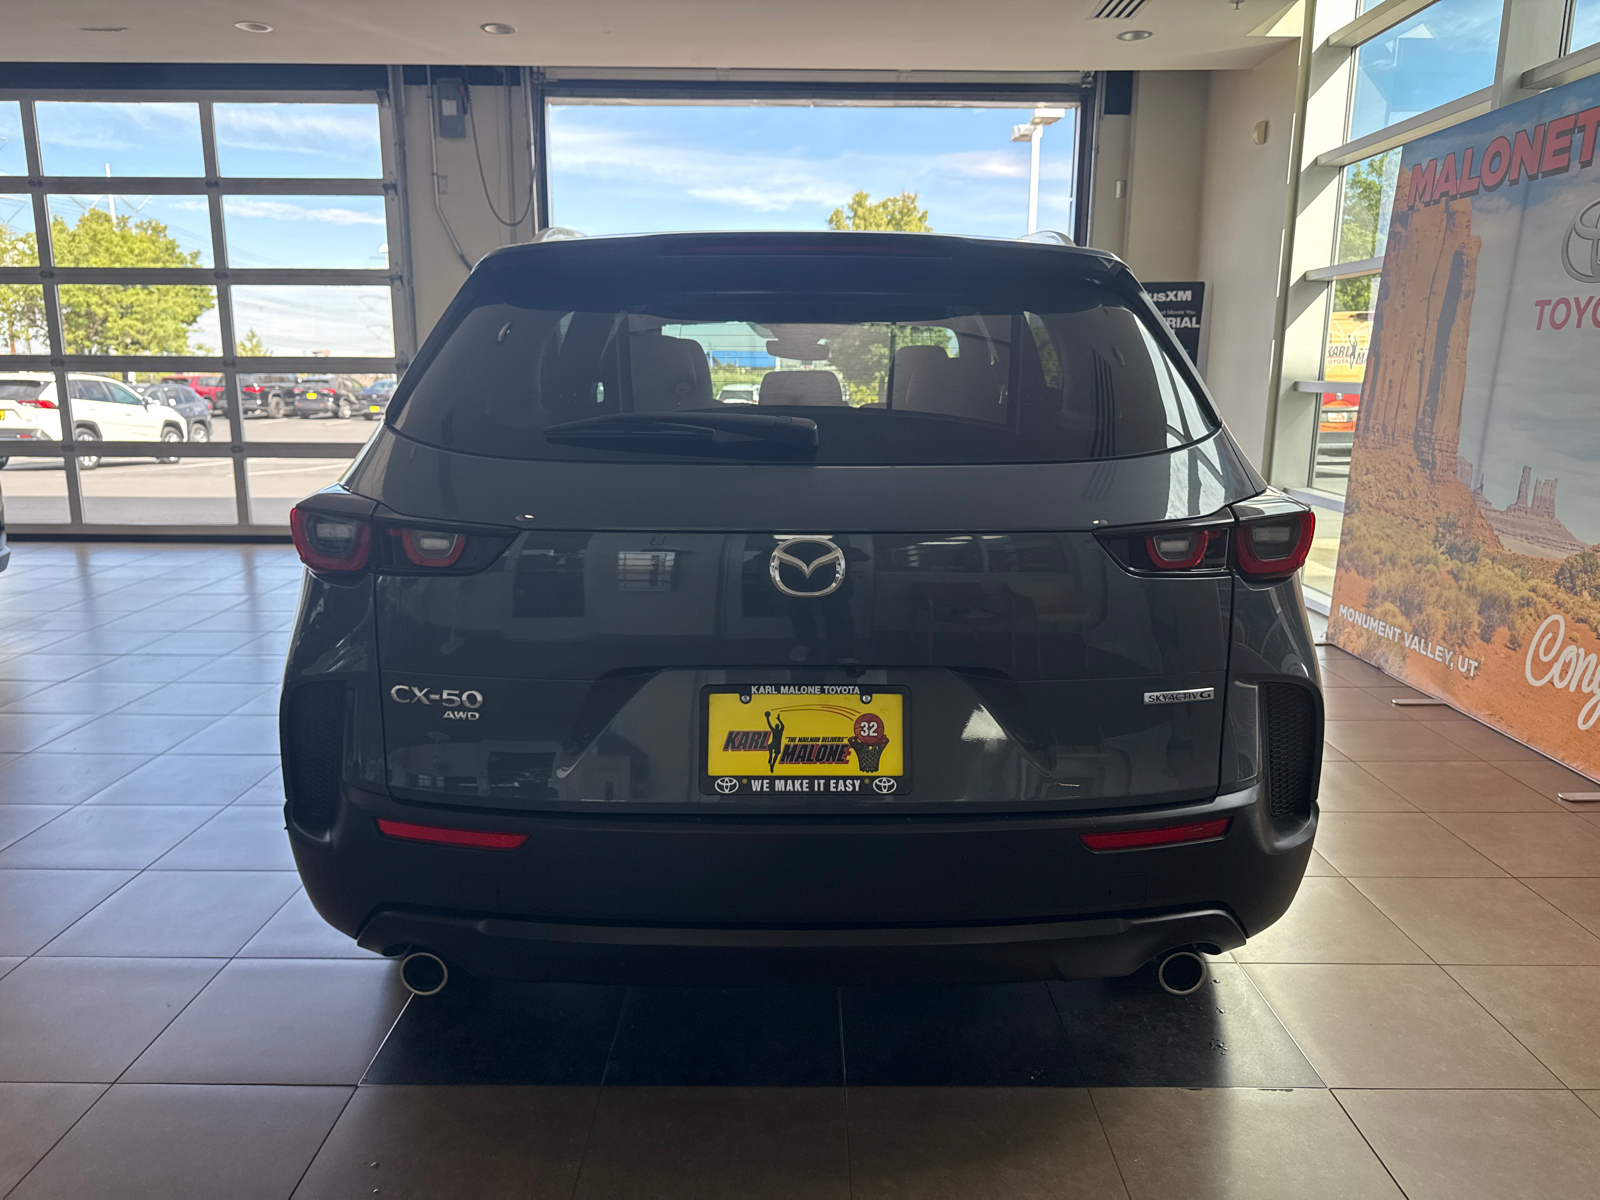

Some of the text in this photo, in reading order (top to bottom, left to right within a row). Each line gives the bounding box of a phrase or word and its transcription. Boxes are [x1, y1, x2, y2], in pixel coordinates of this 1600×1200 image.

[1146, 290, 1192, 302] usXM
[1165, 317, 1200, 329] RIAL
[1338, 604, 1479, 677] MONUMENT VALLEY, UT
[390, 684, 484, 709] CX-50
[751, 685, 860, 694] KARL MALONE TOYOTA
[442, 710, 480, 721] AWD
[860, 721, 878, 737] 32
[723, 730, 772, 752] KARL
[779, 743, 851, 764] MALONE
[751, 779, 861, 791] WE MAKE IT EASY
